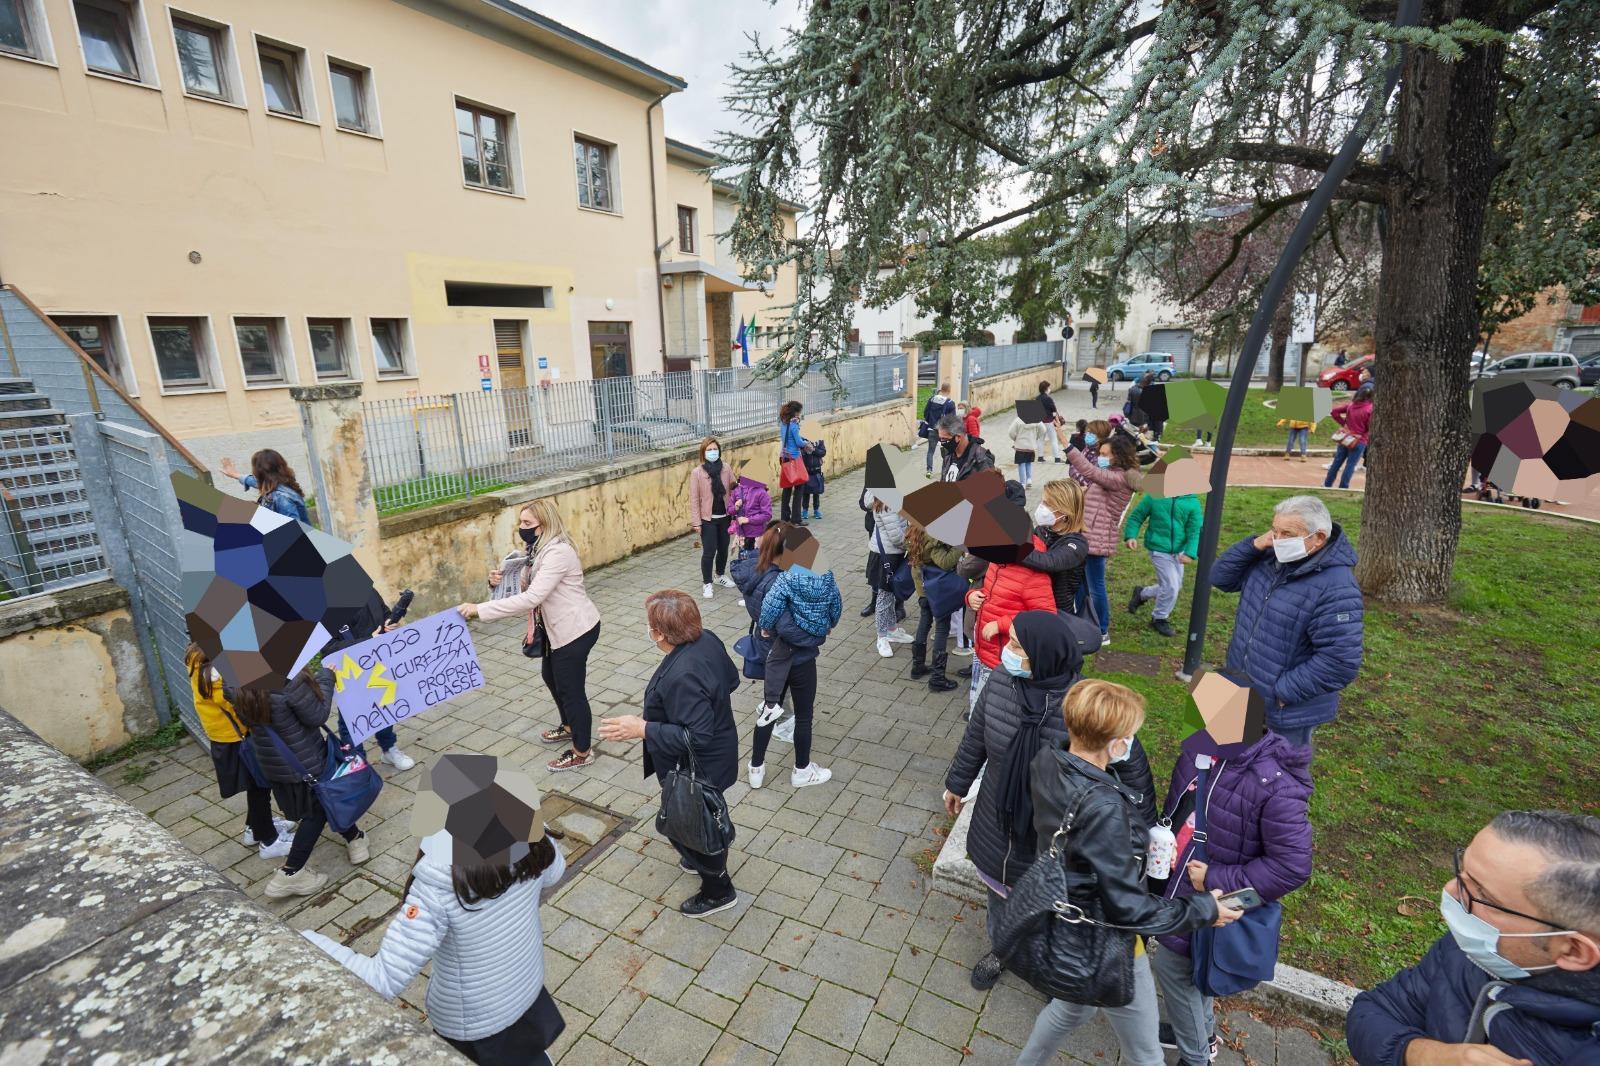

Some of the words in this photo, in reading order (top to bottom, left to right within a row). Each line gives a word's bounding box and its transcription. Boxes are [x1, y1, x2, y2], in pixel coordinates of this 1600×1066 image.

[335, 628, 421, 693] Mensa
[434, 620, 465, 644] in
[424, 672, 481, 706] CLASSE
[351, 698, 411, 737] nella
[417, 660, 481, 695] PROPRIA
